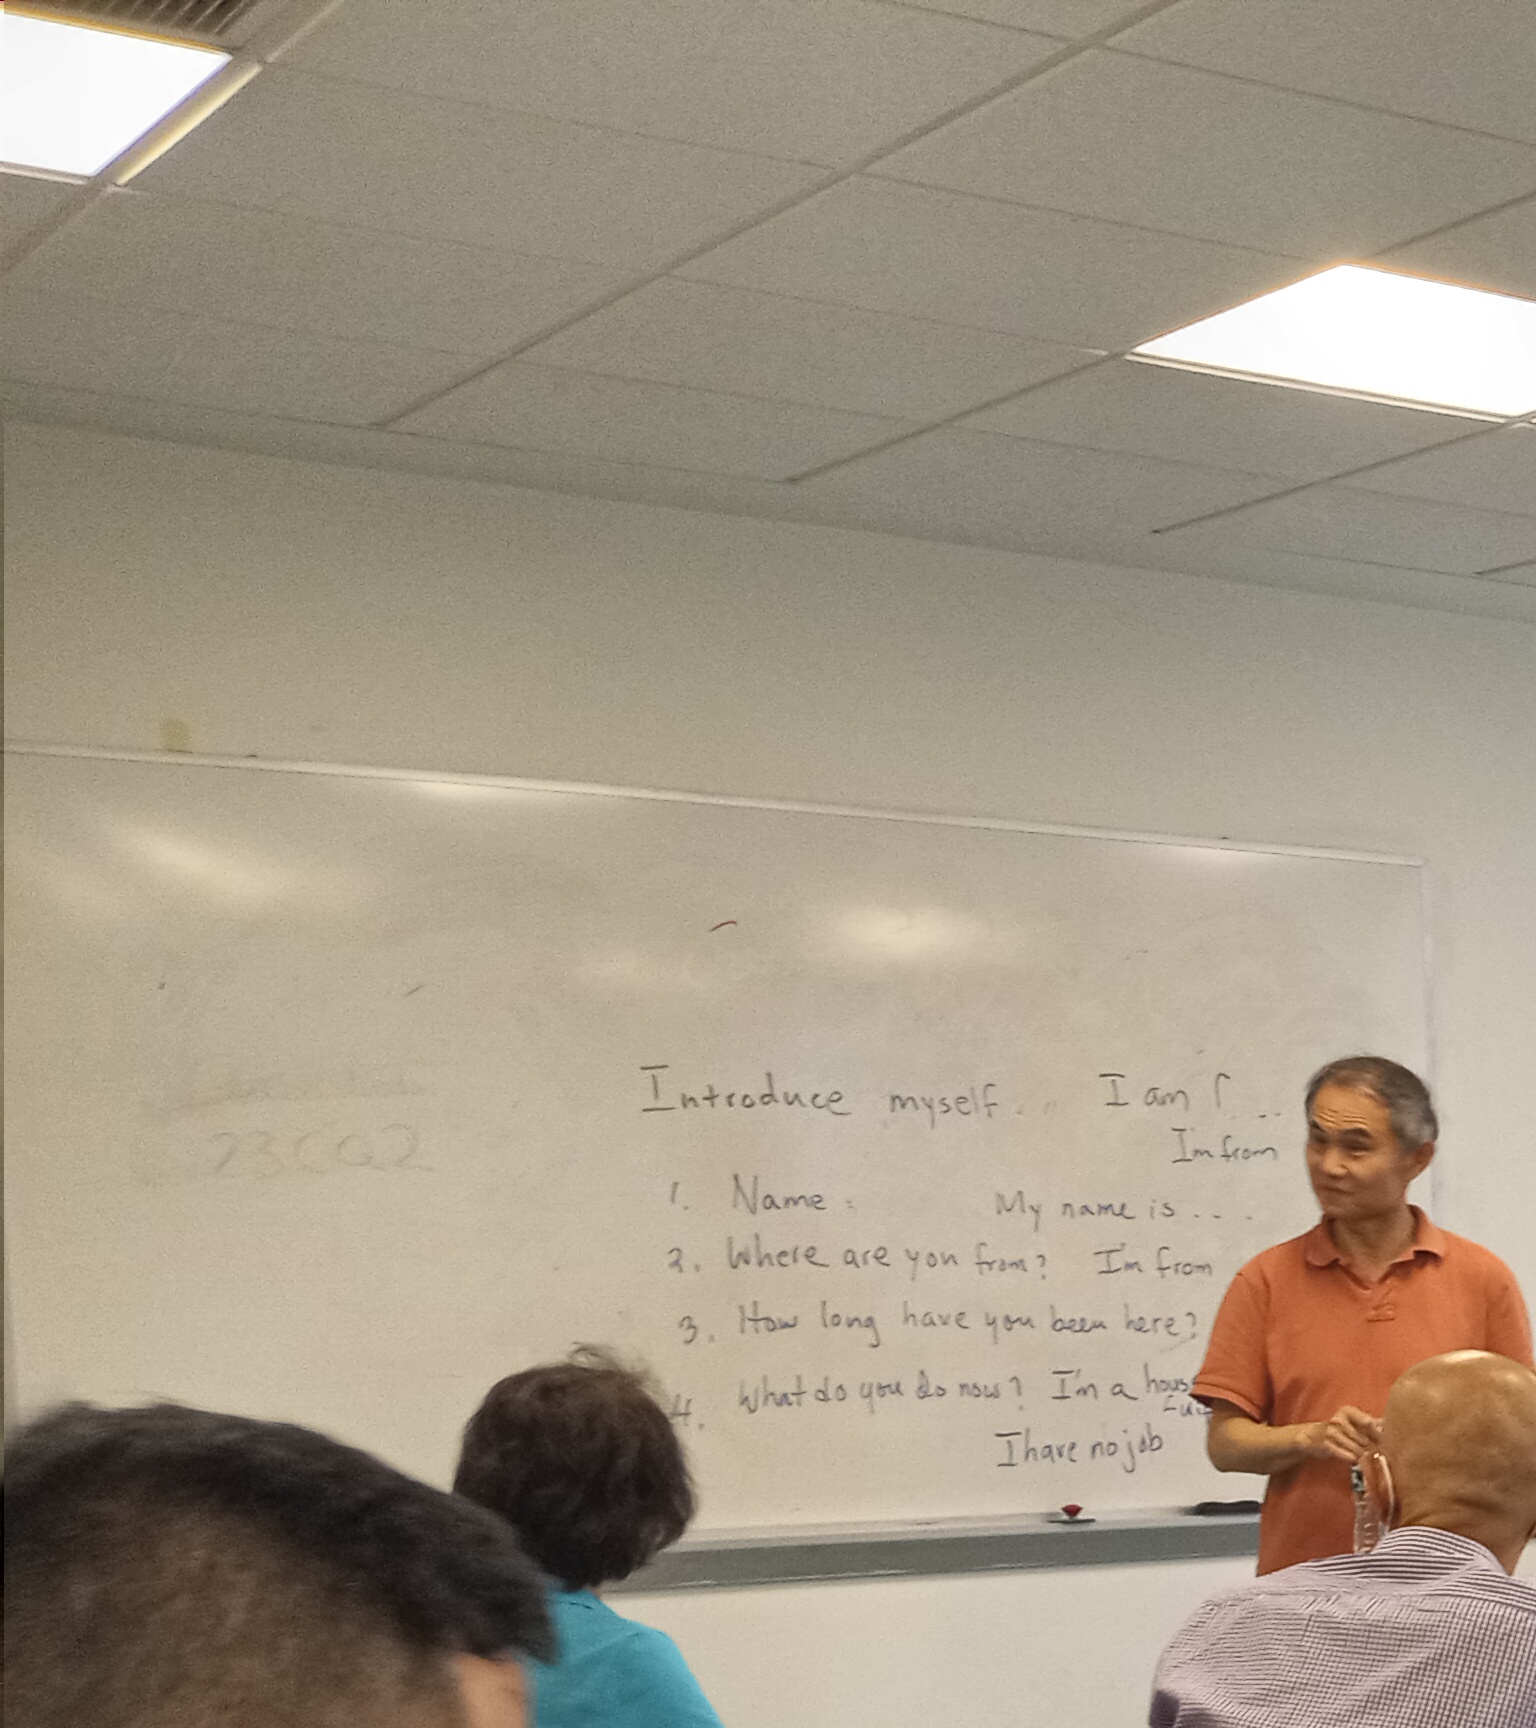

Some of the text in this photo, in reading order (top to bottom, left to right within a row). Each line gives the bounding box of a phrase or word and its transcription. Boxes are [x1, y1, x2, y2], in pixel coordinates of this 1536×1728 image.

[640, 1065, 851, 1116] Introduce
[1099, 1073, 1189, 1110] I am
[1220, 1135, 1278, 1161] from
[995, 1190, 1042, 1232] My
[1061, 1201, 1136, 1219] name
[727, 1233, 830, 1269] Where
[844, 1246, 890, 1268] are
[905, 1247, 959, 1281] you
[975, 1243, 1046, 1280] from?
[1156, 1246, 1213, 1278] from
[738, 1300, 798, 1333] How
[820, 1300, 880, 1348] long
[903, 1300, 970, 1329] have
[985, 1312, 1034, 1344] you
[1050, 1303, 1107, 1332] been
[1124, 1303, 1196, 1339] here?
[738, 1374, 807, 1413] What
[814, 1375, 847, 1401] do
[859, 1381, 904, 1413] you
[917, 1369, 946, 1399] do
[1111, 1383, 1138, 1400] a
[1144, 1363, 1196, 1394] hous
[995, 1422, 1163, 1473] I have no job
